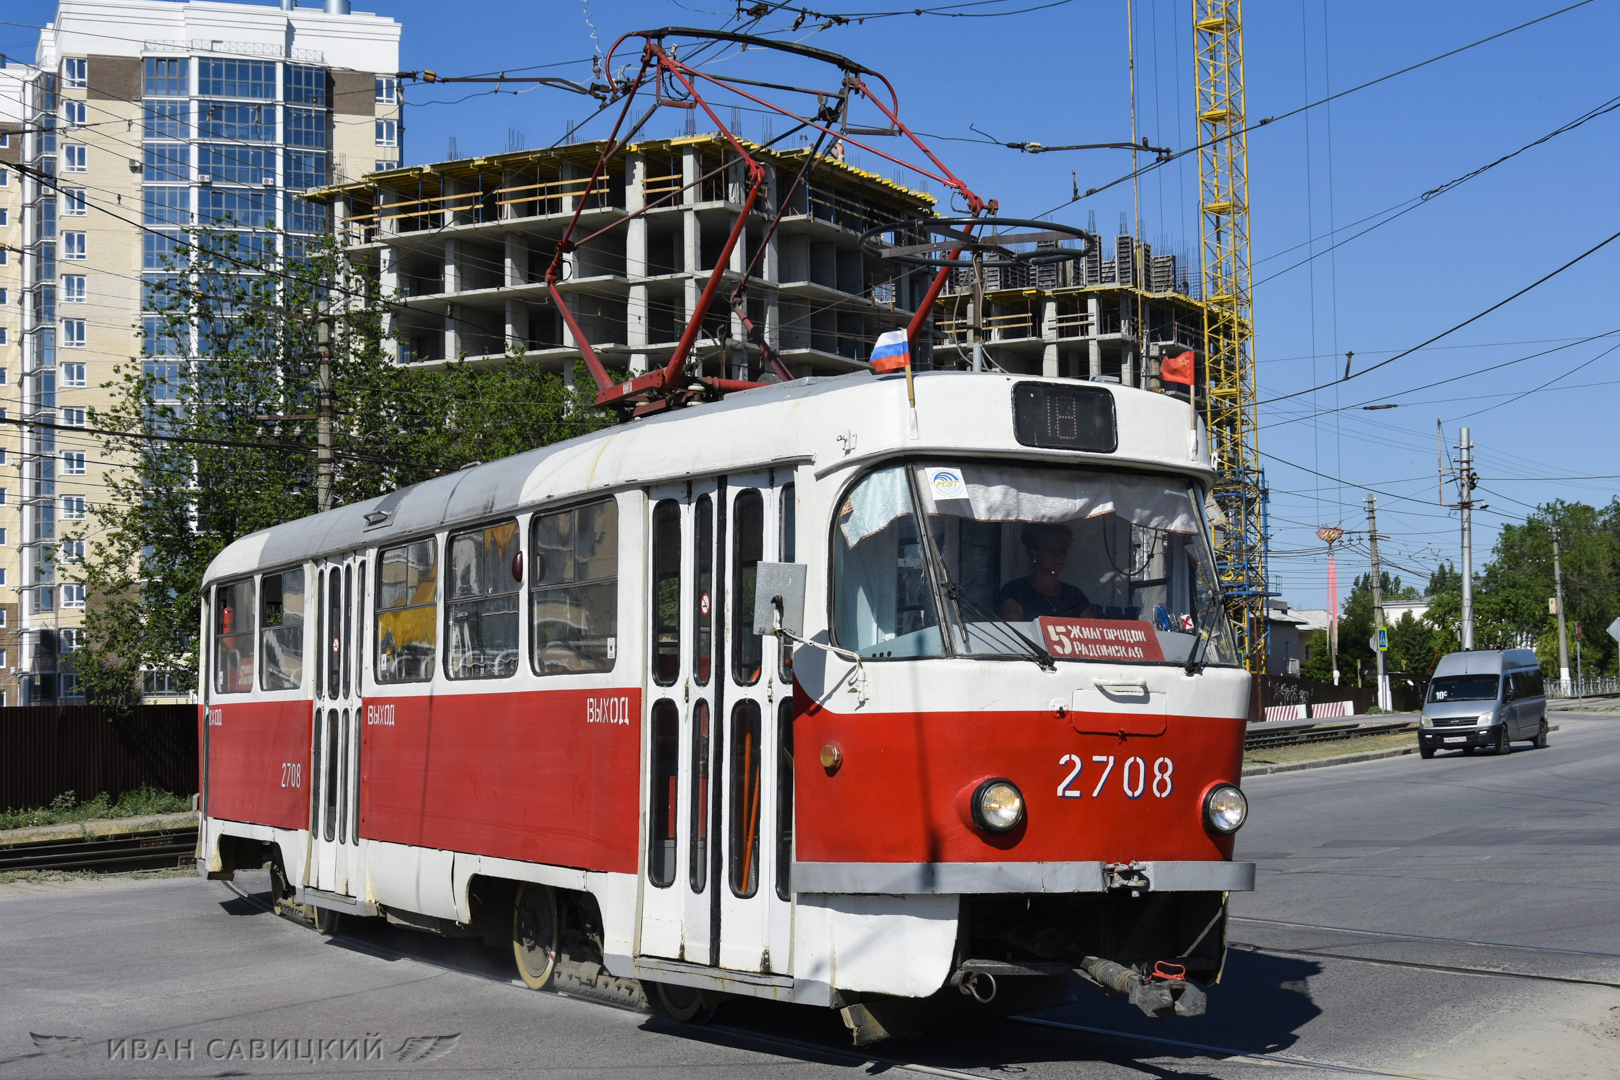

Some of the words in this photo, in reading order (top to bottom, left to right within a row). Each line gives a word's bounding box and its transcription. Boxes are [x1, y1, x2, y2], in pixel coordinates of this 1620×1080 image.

[1046, 625, 1073, 655] 5
[1073, 641, 1144, 658] РАДОМСКАЯ
[367, 704, 395, 726] ВЫХОД
[587, 697, 629, 725] ВЫХОД
[281, 763, 302, 788] 2708
[1057, 754, 1174, 799] 2708
